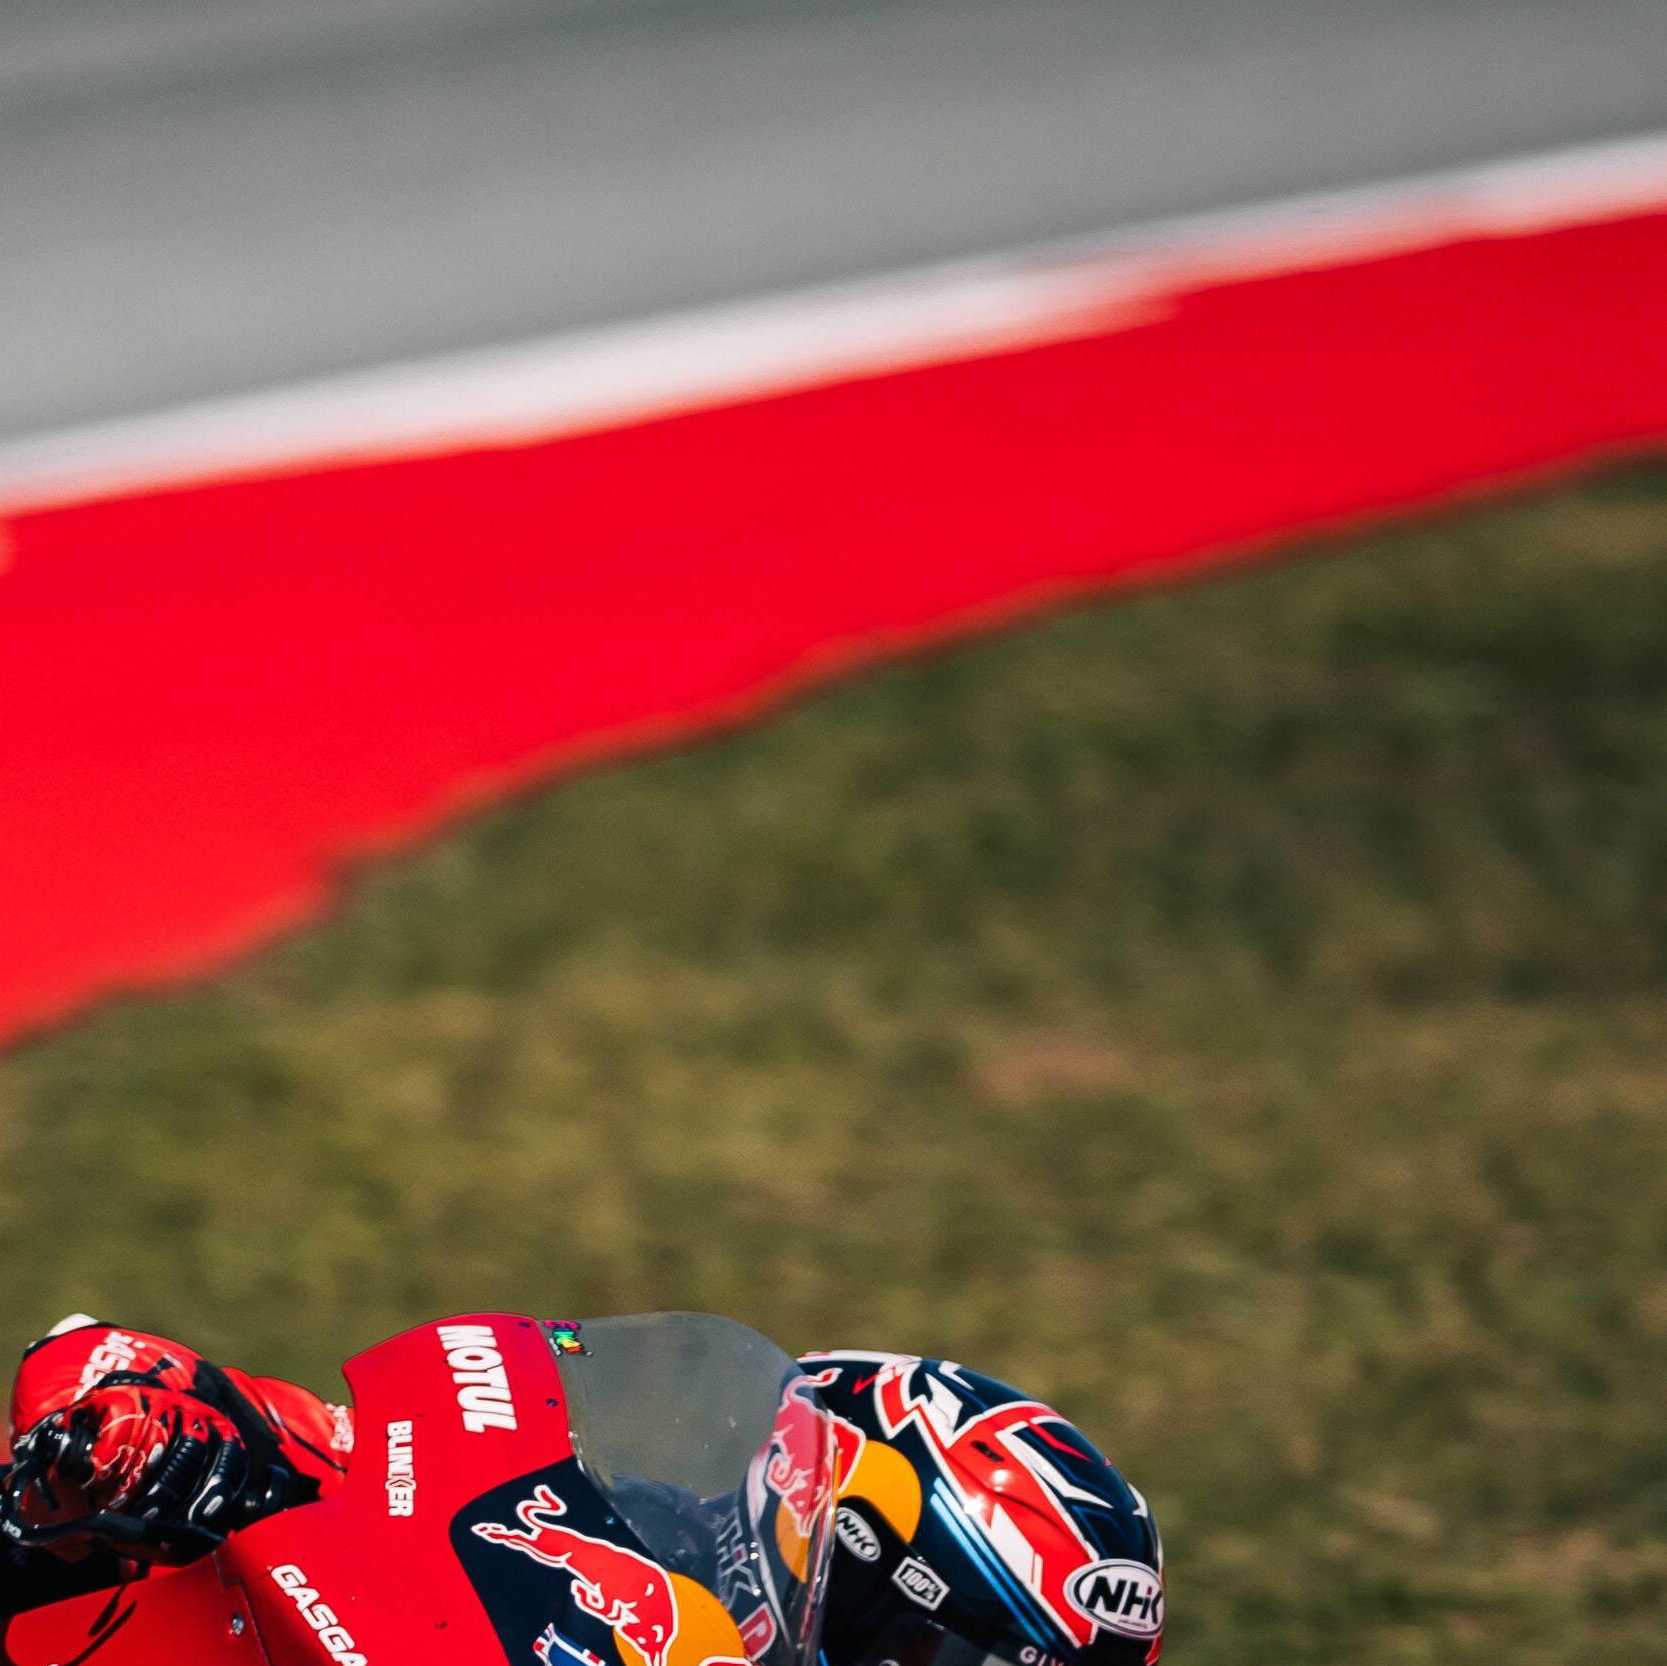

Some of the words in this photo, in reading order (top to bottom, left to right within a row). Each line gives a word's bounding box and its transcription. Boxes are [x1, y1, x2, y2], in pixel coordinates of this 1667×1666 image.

[437, 1325, 517, 1433] MOTUL
[385, 1420, 416, 1516] BLINKER
[901, 1566, 940, 1600] 100%
[1085, 1575, 1163, 1625] NHK
